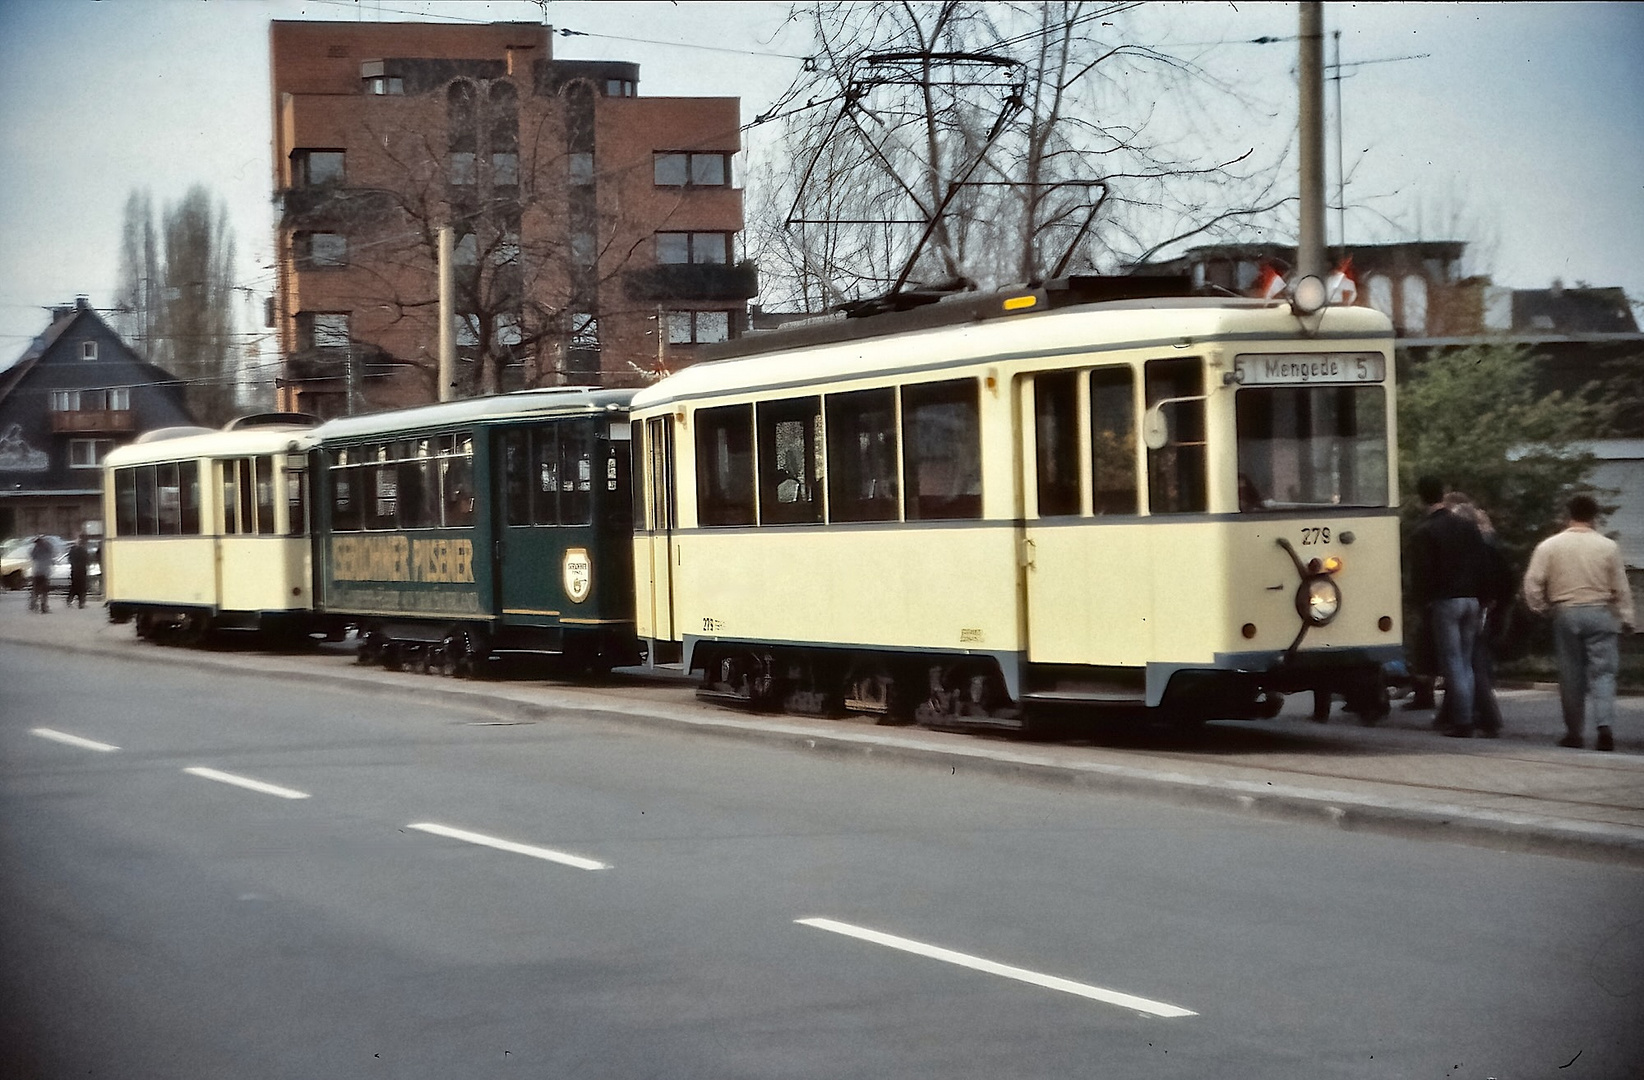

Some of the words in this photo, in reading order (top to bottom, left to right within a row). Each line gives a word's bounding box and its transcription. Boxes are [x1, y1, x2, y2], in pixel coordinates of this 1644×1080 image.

[1265, 357, 1338, 381] Mengede
[1356, 357, 1368, 380] 5
[1301, 527, 1330, 545] 279
